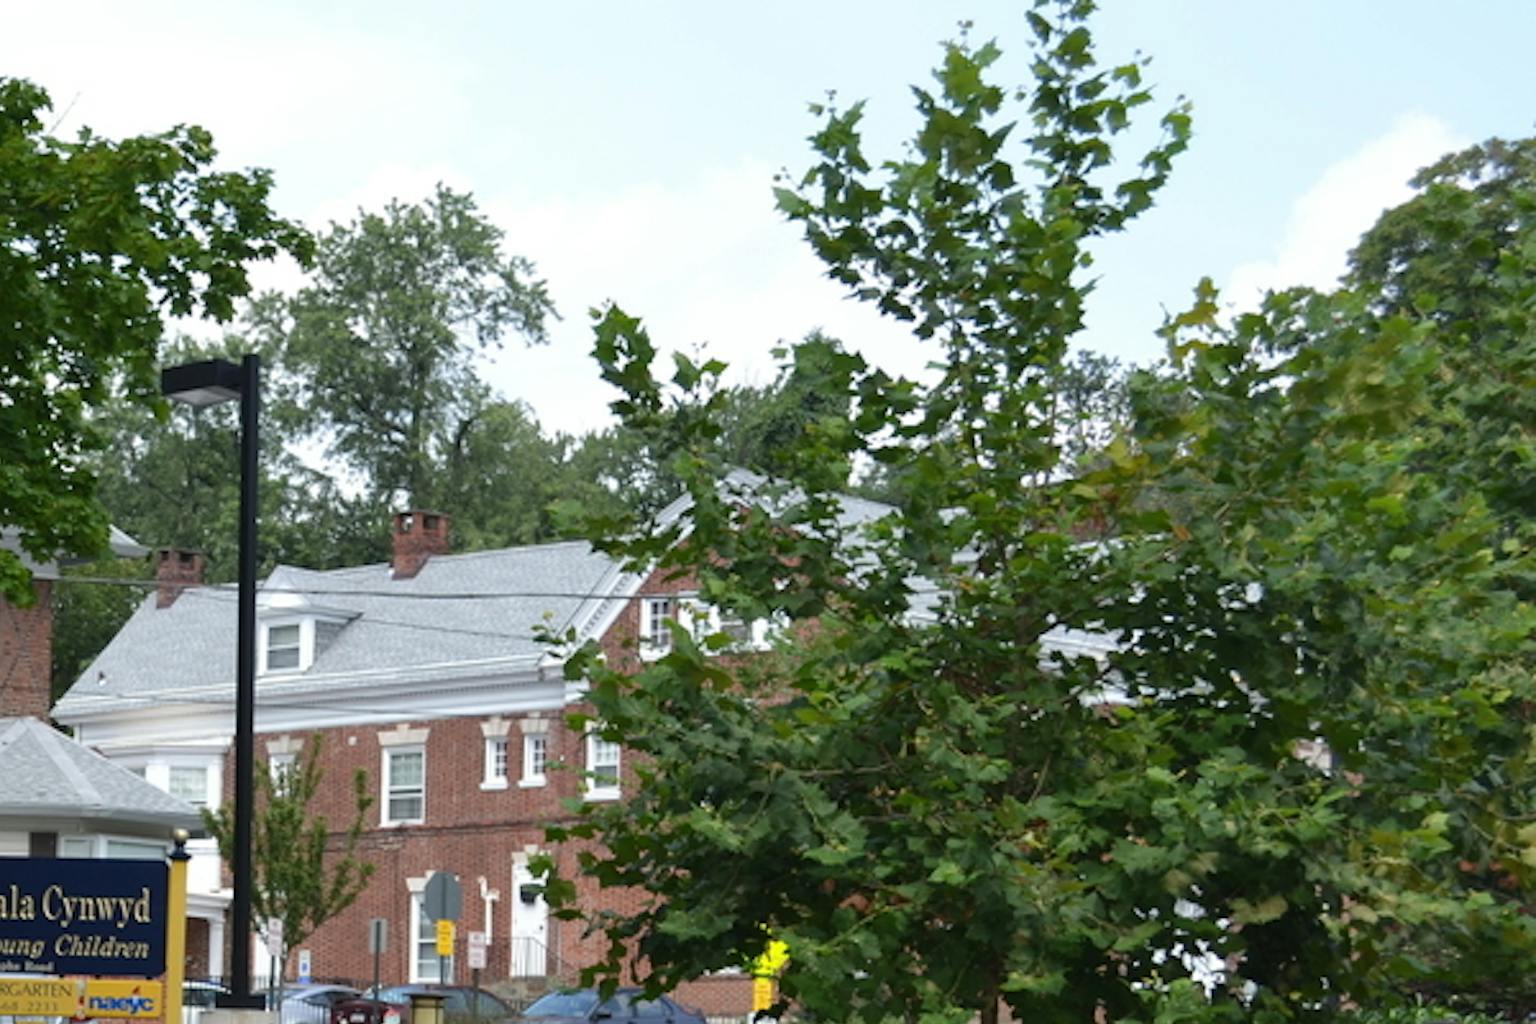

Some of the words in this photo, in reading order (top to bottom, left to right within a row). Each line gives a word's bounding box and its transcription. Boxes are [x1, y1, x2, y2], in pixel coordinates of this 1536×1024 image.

[42, 884, 151, 928] Cynwyd
[54, 934, 150, 959] Children
[89, 992, 154, 1014] naeyc
